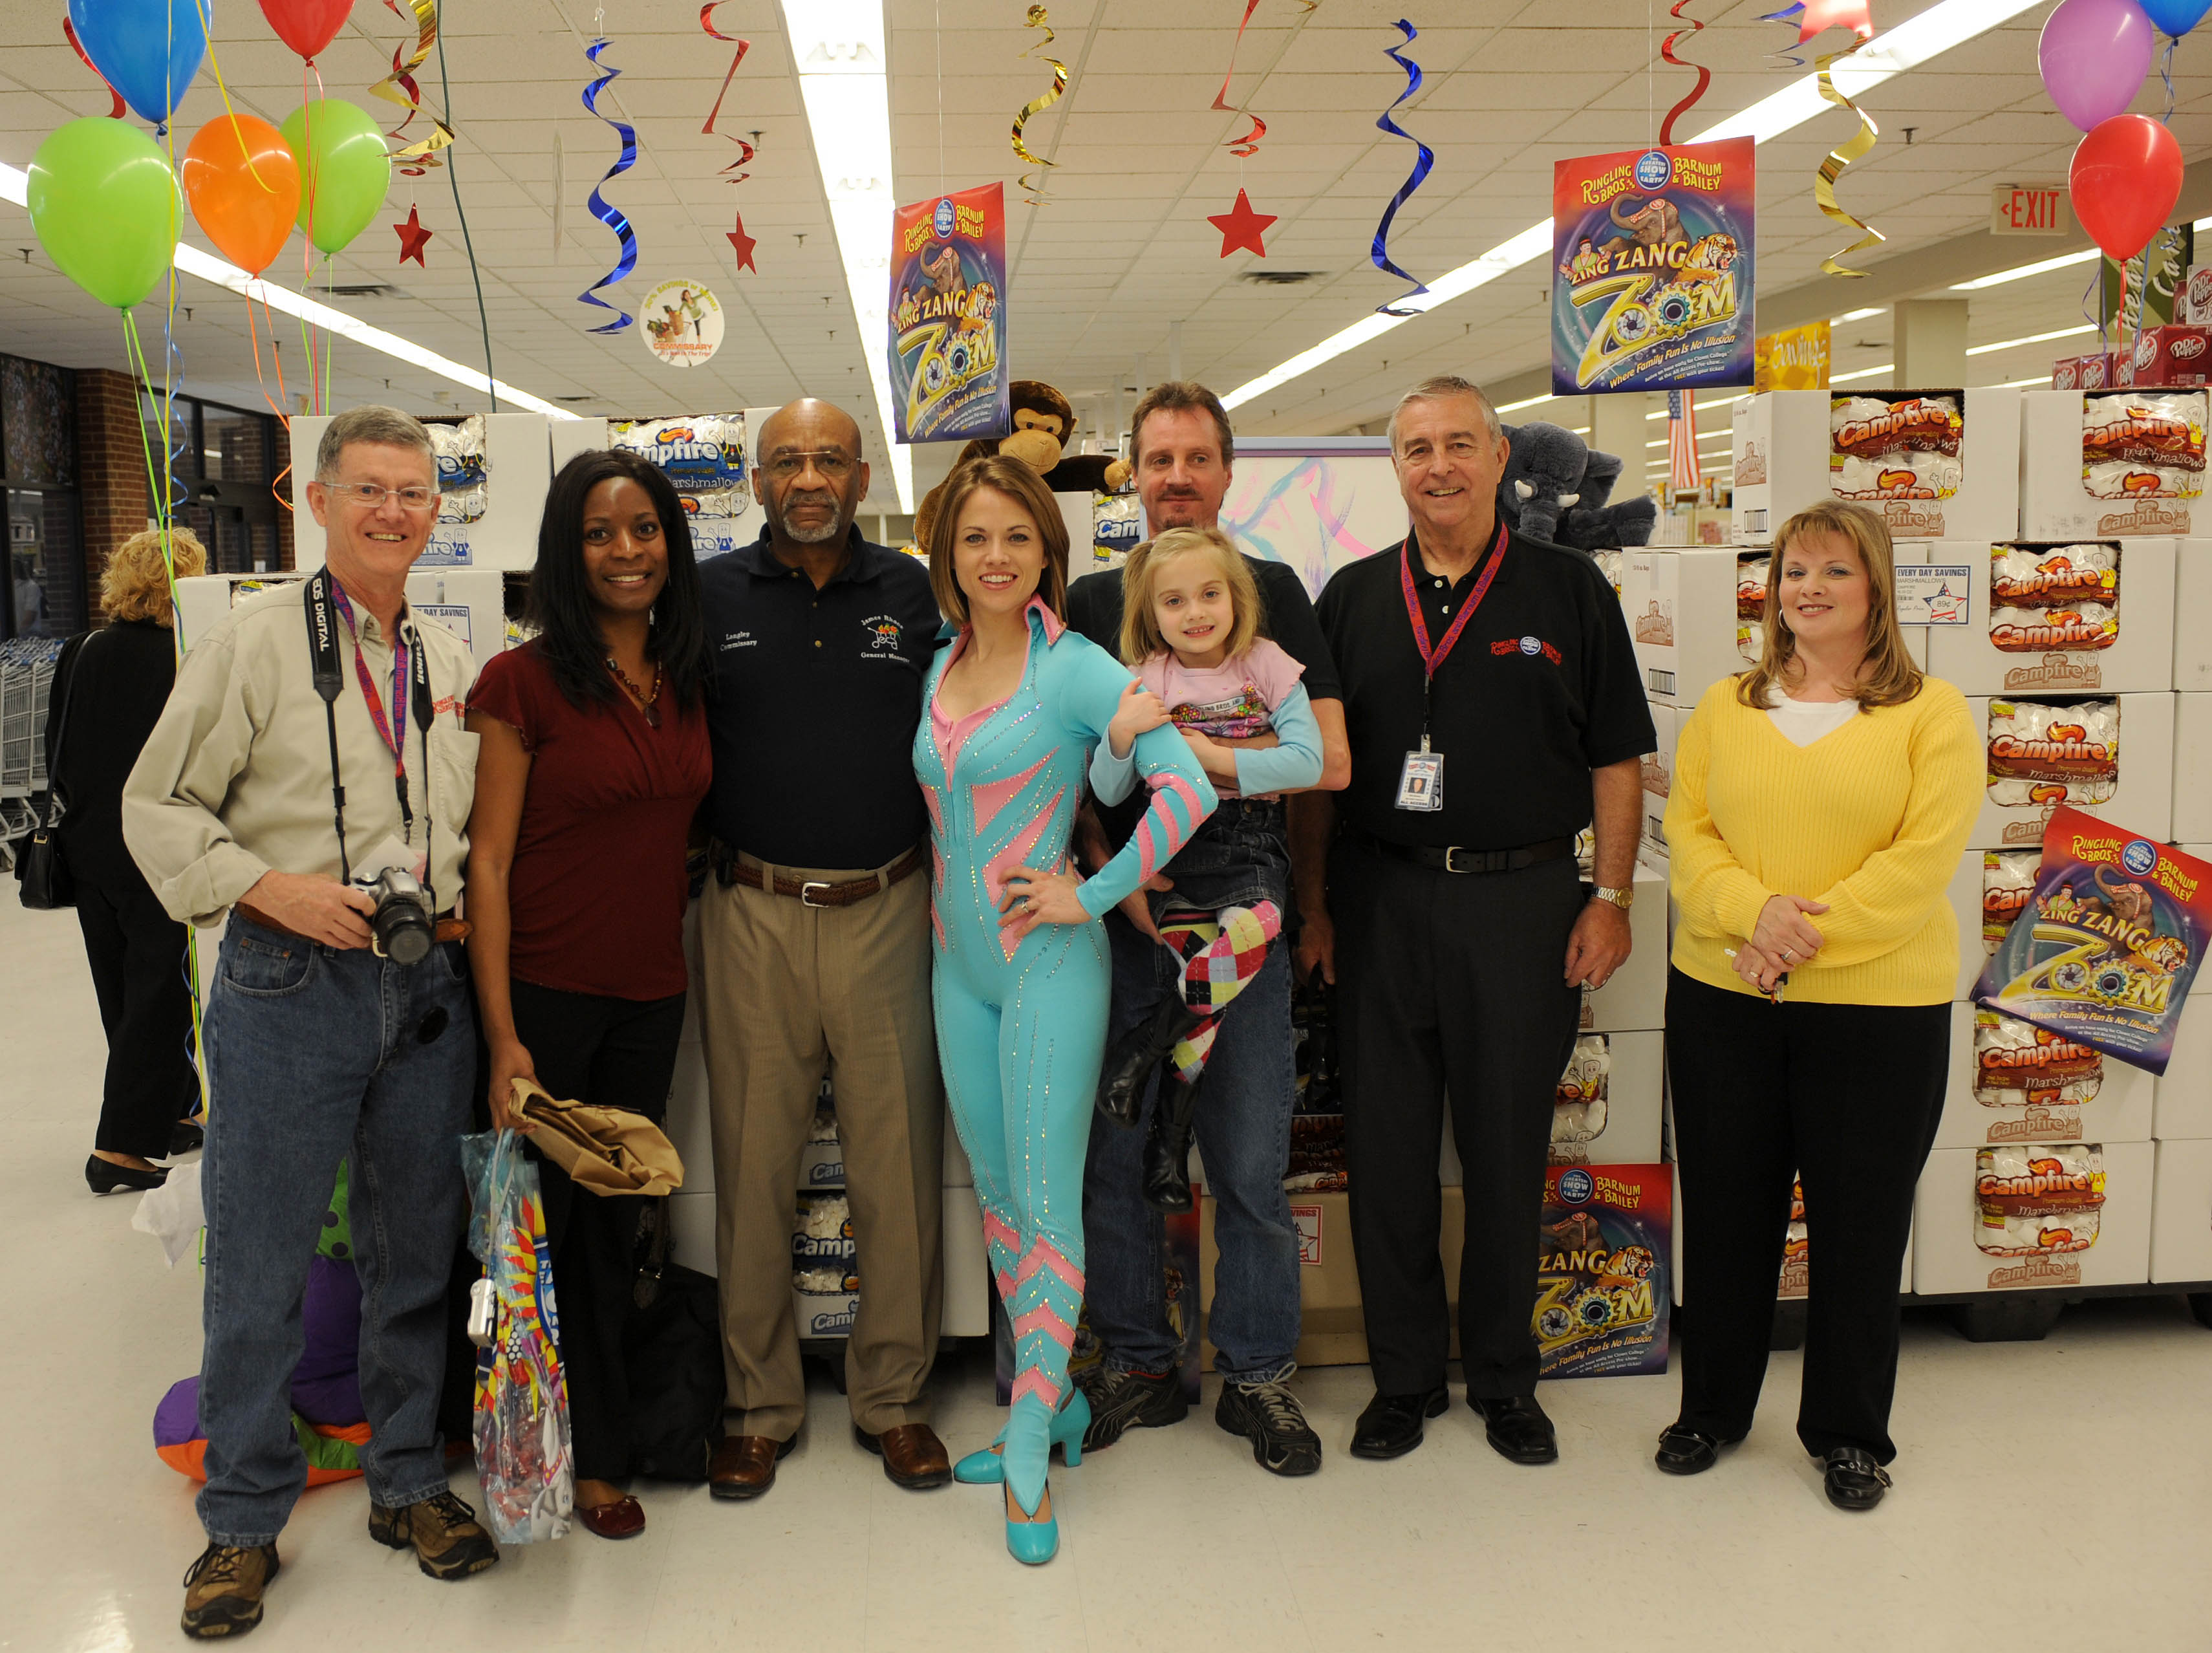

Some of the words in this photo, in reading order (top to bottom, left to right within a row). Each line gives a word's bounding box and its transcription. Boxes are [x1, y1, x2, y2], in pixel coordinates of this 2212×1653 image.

[1640, 166, 1666, 175] SHOW
[1673, 157, 1722, 176] BARNUM
[1580, 165, 1631, 205] RINGLING
[1600, 178, 1629, 203] BROS.
[1672, 175, 1679, 184] &
[1681, 171, 1721, 191] BAILEY
[956, 205, 984, 224] BARNUM
[2011, 190, 2059, 228] EXIT
[905, 213, 933, 254] RINGLING
[956, 223, 960, 232] &
[961, 217, 984, 238] BAILEY
[1570, 260, 1610, 285] ZING
[1614, 241, 1689, 272] ZANG
[897, 308, 920, 334] ZING
[922, 290, 967, 320] ZANG
[1570, 272, 1738, 388] ZOOM
[653, 343, 713, 351] COMMISSARY
[2171, 341, 2203, 357] Pepper
[2184, 338, 2196, 348] Dr
[1609, 369, 1635, 389] Where
[1636, 354, 1664, 374] Family
[1665, 348, 1681, 360] Fun
[1681, 343, 1690, 356] Is
[1690, 340, 1702, 351] No
[1704, 334, 1736, 348] Illusion
[2136, 345, 2155, 369] Pepper
[897, 319, 998, 439] ZOOM
[925, 419, 938, 439] Where
[938, 403, 954, 424] Family
[955, 397, 964, 411] Fun
[970, 390, 977, 402] No
[1837, 404, 1945, 448] Campfire
[2083, 418, 2189, 446] Campfire
[616, 438, 719, 467] mpfire
[671, 476, 738, 490] arshmallow
[1884, 510, 1926, 528] pfire
[2101, 510, 2173, 533] Campfire
[1897, 568, 1917, 577] EVERY
[1935, 568, 1967, 577] SAVINGS
[1996, 567, 2098, 596] Campfire
[312, 578, 323, 600] EOS
[439, 609, 467, 617] SAVINGS
[315, 603, 330, 652] DIGITAL
[725, 631, 750, 640] Langley
[1991, 620, 2103, 645] Campfire
[720, 640, 757, 651] Commissary
[2006, 660, 2083, 686] Campfire
[1992, 737, 2106, 763] Campfire
[2072, 835, 2122, 860] RINGLING
[2088, 849, 2114, 863] BROS.
[2127, 848, 2153, 866] SHOW
[2151, 870, 2160, 880] &
[2160, 872, 2194, 902] BAILEY
[2157, 857, 2198, 891] BARNUM
[2039, 909, 2079, 924] ZING
[2082, 911, 2151, 951] ZANG
[1999, 924, 2176, 1015] ZOOM
[2030, 1011, 2057, 1021] Where
[2059, 1010, 2088, 1022] Family
[2089, 1012, 2105, 1021] Fun
[2105, 1014, 2114, 1023] Is
[2114, 1016, 2127, 1026] No
[2129, 1019, 2160, 1035] Illusion
[1982, 1039, 2092, 1068] Campfire
[1990, 1116, 2064, 1140] Campfire
[1563, 1181, 1589, 1190] SHOW
[1595, 1176, 1640, 1196] BARNUM
[1979, 1169, 2087, 1197] Campfire
[1594, 1192, 1601, 1200] &
[1604, 1189, 1641, 1209] BAILEY
[792, 1235, 855, 1259] Camp
[1538, 1249, 1607, 1274] ZANG
[1991, 1262, 2063, 1285] Campfire
[1540, 1363, 1558, 1376] here
[1558, 1351, 1586, 1367] Family
[1586, 1344, 1601, 1356] Fun
[1602, 1341, 1609, 1352] Is
[1611, 1339, 1623, 1349] No
[1624, 1334, 1653, 1346] Illusion
